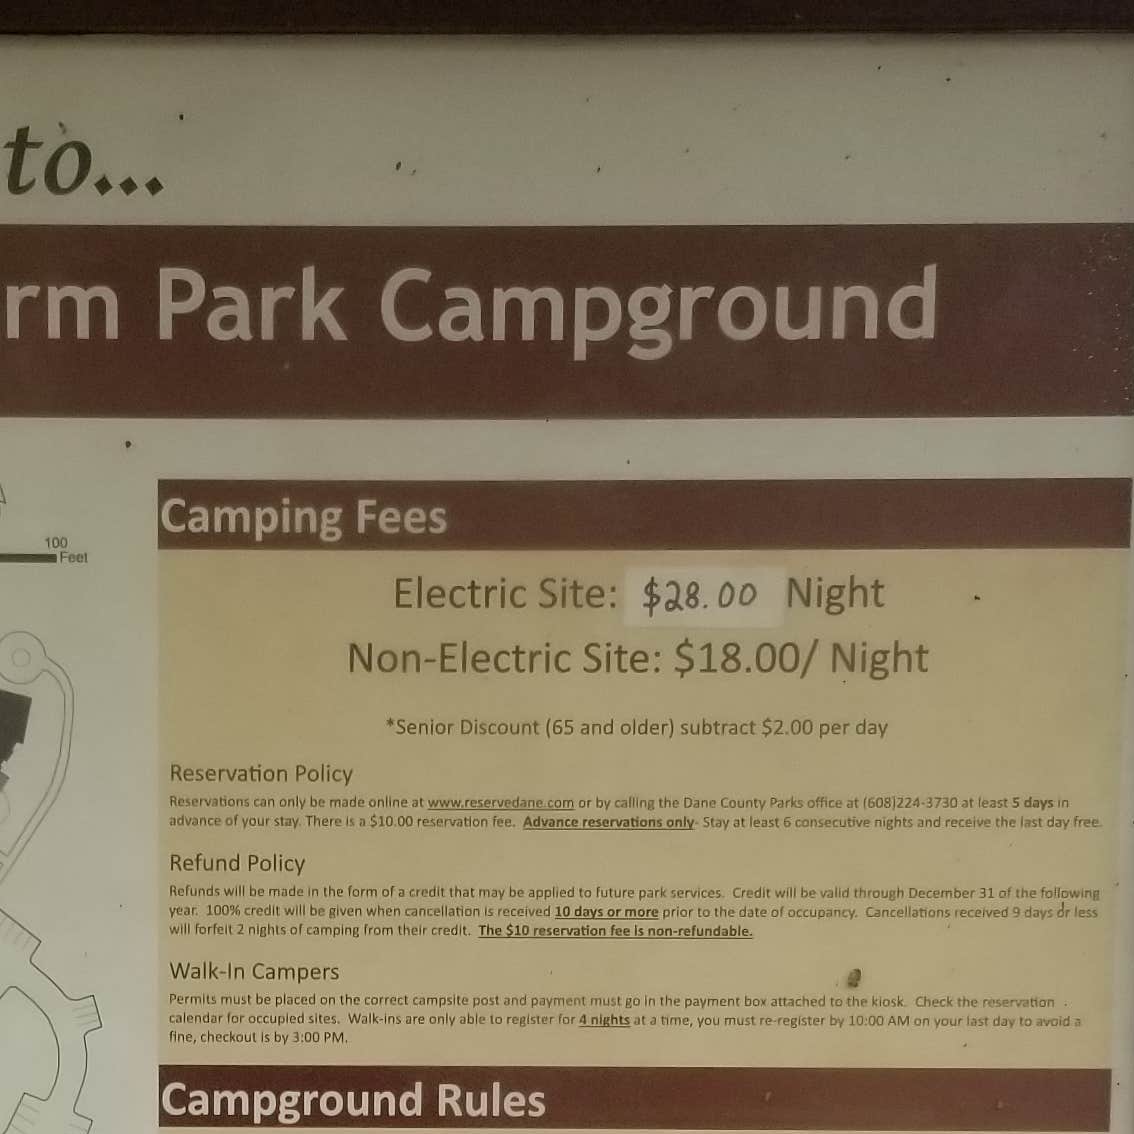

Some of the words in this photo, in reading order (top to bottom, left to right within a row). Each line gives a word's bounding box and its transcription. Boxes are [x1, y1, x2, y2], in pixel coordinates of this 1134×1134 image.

[3, 126, 164, 196] to...
[159, 266, 347, 341] Park
[381, 264, 938, 361] Campground
[161, 498, 343, 542] Camping
[357, 499, 447, 534] Fees
[44, 537, 68, 549] 100
[59, 551, 88, 564] Feet
[395, 577, 527, 609] Electric
[538, 577, 617, 609] Site:
[643, 577, 757, 618] $28.00
[788, 576, 885, 616] Night
[348, 641, 572, 675] Non-Electric
[583, 641, 661, 674] Site:
[674, 637, 819, 680] $18.00/
[831, 641, 929, 680] Night
[461, 718, 540, 735] Discount
[545, 717, 573, 739] (65
[581, 718, 613, 736] and
[620, 718, 674, 739] older)
[681, 718, 756, 736] subtract
[762, 717, 813, 738] $2.00
[820, 723, 850, 740] per
[856, 718, 888, 740] day
[170, 764, 287, 782] Reservation
[296, 763, 353, 786] Policy
[170, 853, 239, 872] Refund
[248, 853, 305, 876] Policy
[170, 961, 244, 981] Walk-In
[253, 962, 339, 984] Campers
[170, 1031, 197, 1045] fine,
[201, 1031, 256, 1043] checkout
[261, 1032, 270, 1043] is
[275, 1031, 289, 1046] by
[293, 1032, 320, 1043] 3:00
[324, 1032, 348, 1043] PM.
[161, 1081, 423, 1124] Campground
[438, 1081, 546, 1117] Rules
